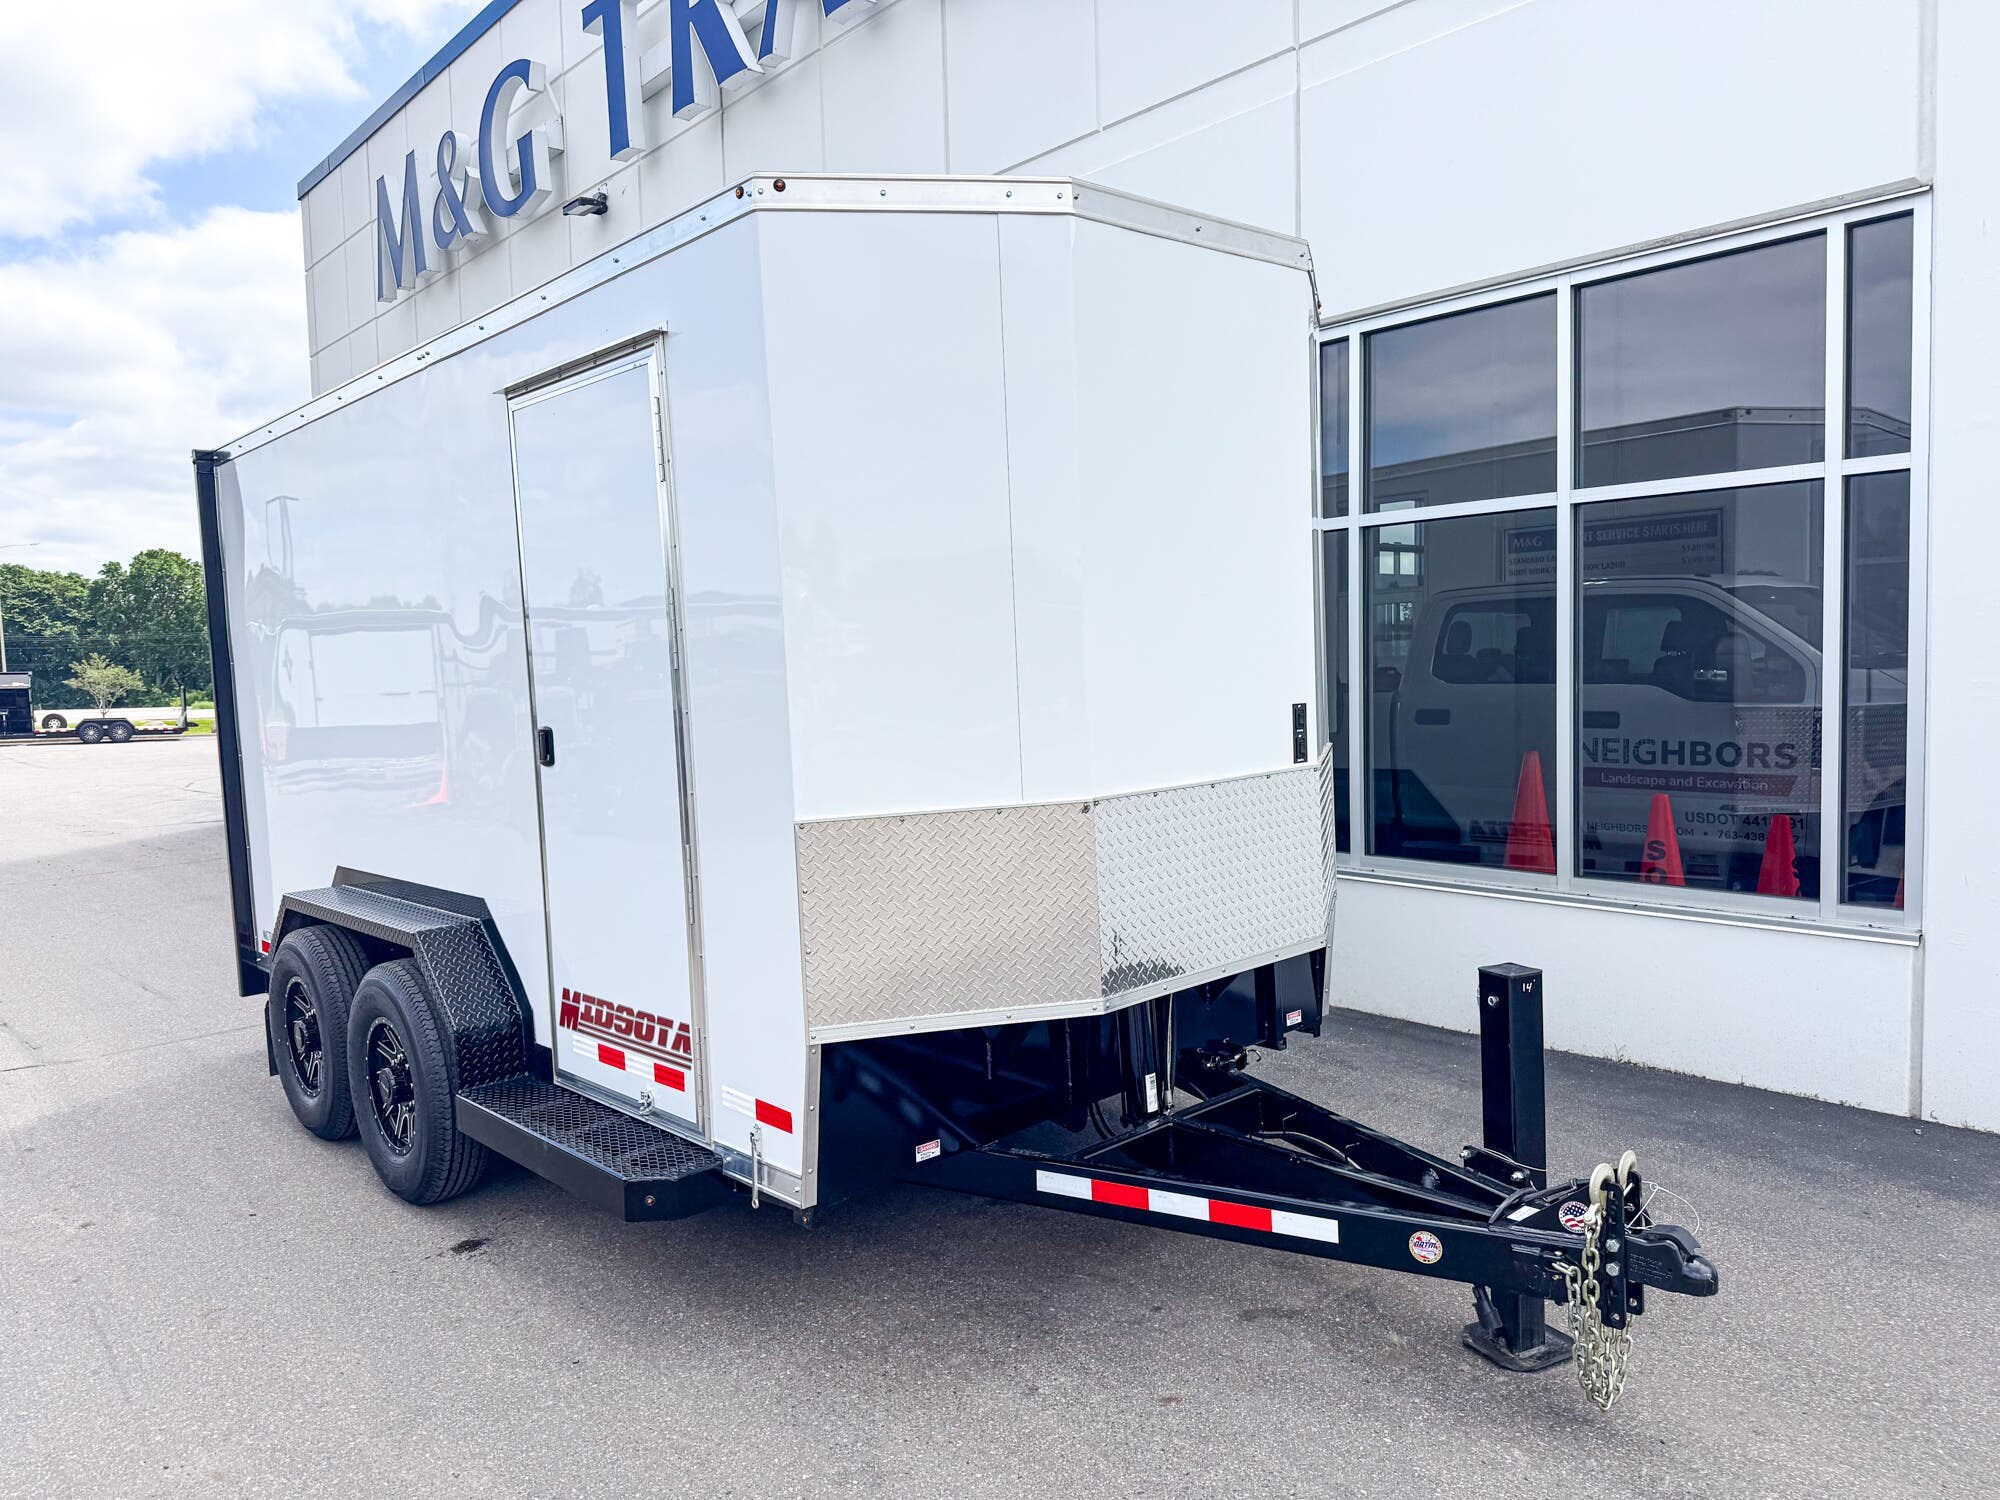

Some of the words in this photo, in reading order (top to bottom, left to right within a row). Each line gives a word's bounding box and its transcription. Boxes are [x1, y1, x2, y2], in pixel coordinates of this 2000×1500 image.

[376, 58, 551, 301] M&G
[1596, 527, 1641, 541] SERVICE
[1583, 737, 1797, 769] NEIGHBORS
[1601, 772, 1666, 787] Landscape
[1669, 776, 1693, 788] and
[1696, 777, 1768, 791] Excavation
[1685, 811, 1738, 825] USDOT
[1742, 815, 1804, 830] 44191
[560, 987, 692, 1055] MIDSOTA
